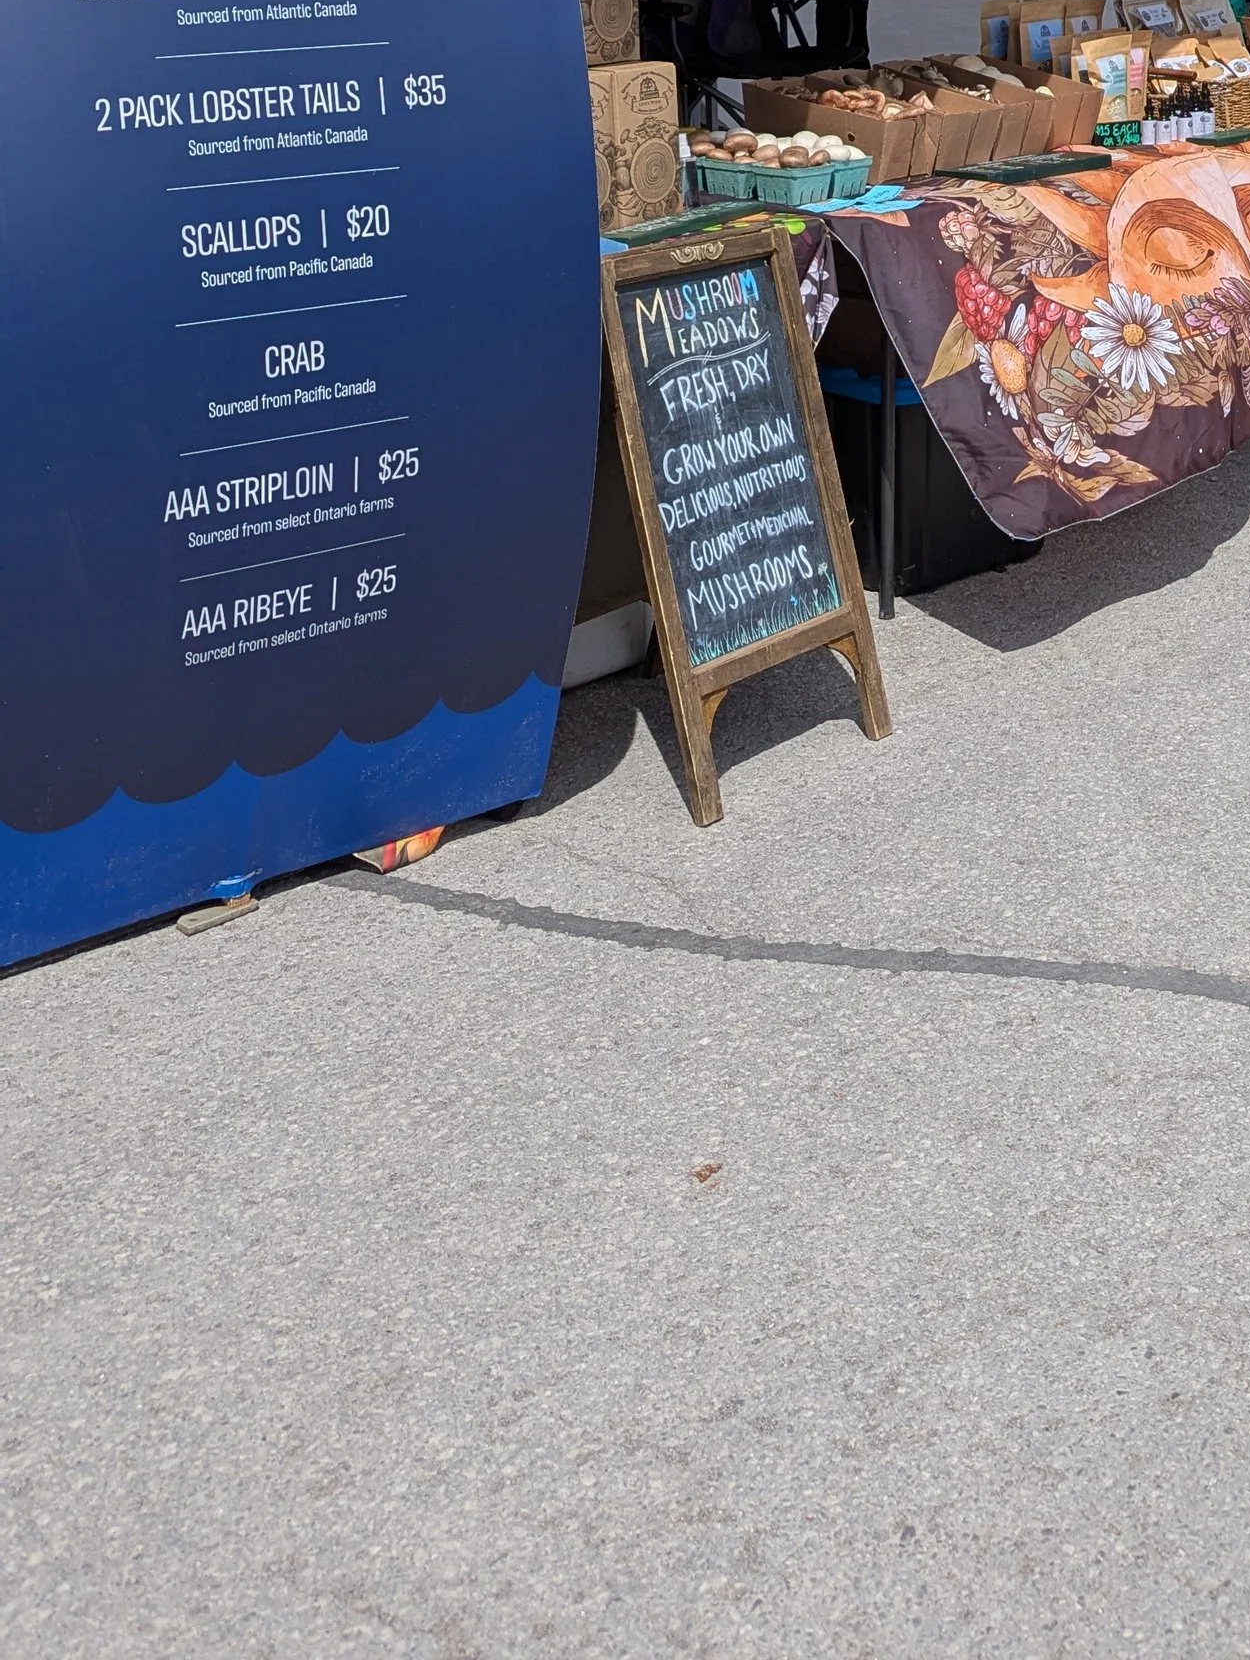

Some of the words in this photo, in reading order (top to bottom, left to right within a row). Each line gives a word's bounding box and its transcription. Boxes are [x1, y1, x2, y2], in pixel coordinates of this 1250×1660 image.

[177, 7, 230, 26] Sourced
[232, 5, 264, 22] from
[266, 3, 312, 20] Atlantic
[314, 1, 357, 18] Canada
[95, 98, 113, 132] 2
[118, 92, 183, 130] PACK
[189, 85, 295, 125] LOBSTER
[299, 80, 360, 116] TAILS
[403, 73, 446, 110] $35
[188, 136, 240, 157] Sourced
[242, 134, 275, 151] from
[277, 130, 323, 149] Atlantic
[325, 126, 368, 146] Canada
[1095, 124, 1111, 137] $15
[1112, 123, 1139, 137] EACH
[1103, 137, 1114, 146] OR
[1116, 134, 1141, 146] 3/$40
[181, 213, 301, 257] SCALLOPS
[346, 204, 390, 241] $20
[201, 268, 253, 288] Sourced
[256, 264, 287, 283] from
[289, 258, 328, 278] Pacific
[331, 253, 373, 273] Canada
[635, 268, 759, 368] MUSHROOM
[265, 340, 325, 378] CRAB
[659, 366, 737, 421] FRESH,
[734, 349, 770, 393] DRY
[208, 397, 259, 418] Sourced
[261, 393, 292, 411] from
[294, 386, 332, 406] Pacific
[334, 378, 376, 399] Canada
[662, 439, 715, 485] GROW
[714, 423, 759, 466] YOUR
[759, 412, 796, 450] OWN
[164, 485, 210, 522] AAA
[216, 462, 334, 513] STRIPLOIN
[378, 447, 420, 484] $25
[734, 454, 807, 505] NUTRITIOUS
[188, 526, 239, 548] Sourced
[242, 521, 272, 538] from
[275, 512, 311, 533] select
[313, 503, 357, 525] Ontario
[359, 495, 394, 517] farms
[689, 522, 750, 573] GOURMET
[755, 504, 814, 543] MEDICINAL
[182, 604, 227, 639] AAA
[233, 584, 313, 628] RIBEYE
[356, 565, 397, 601] $25
[687, 544, 813, 632] MUSHROOMS
[185, 644, 235, 667] Sourced
[238, 637, 269, 656] from
[271, 627, 306, 648] select
[308, 616, 351, 638] Ontario
[353, 606, 387, 626] farms
